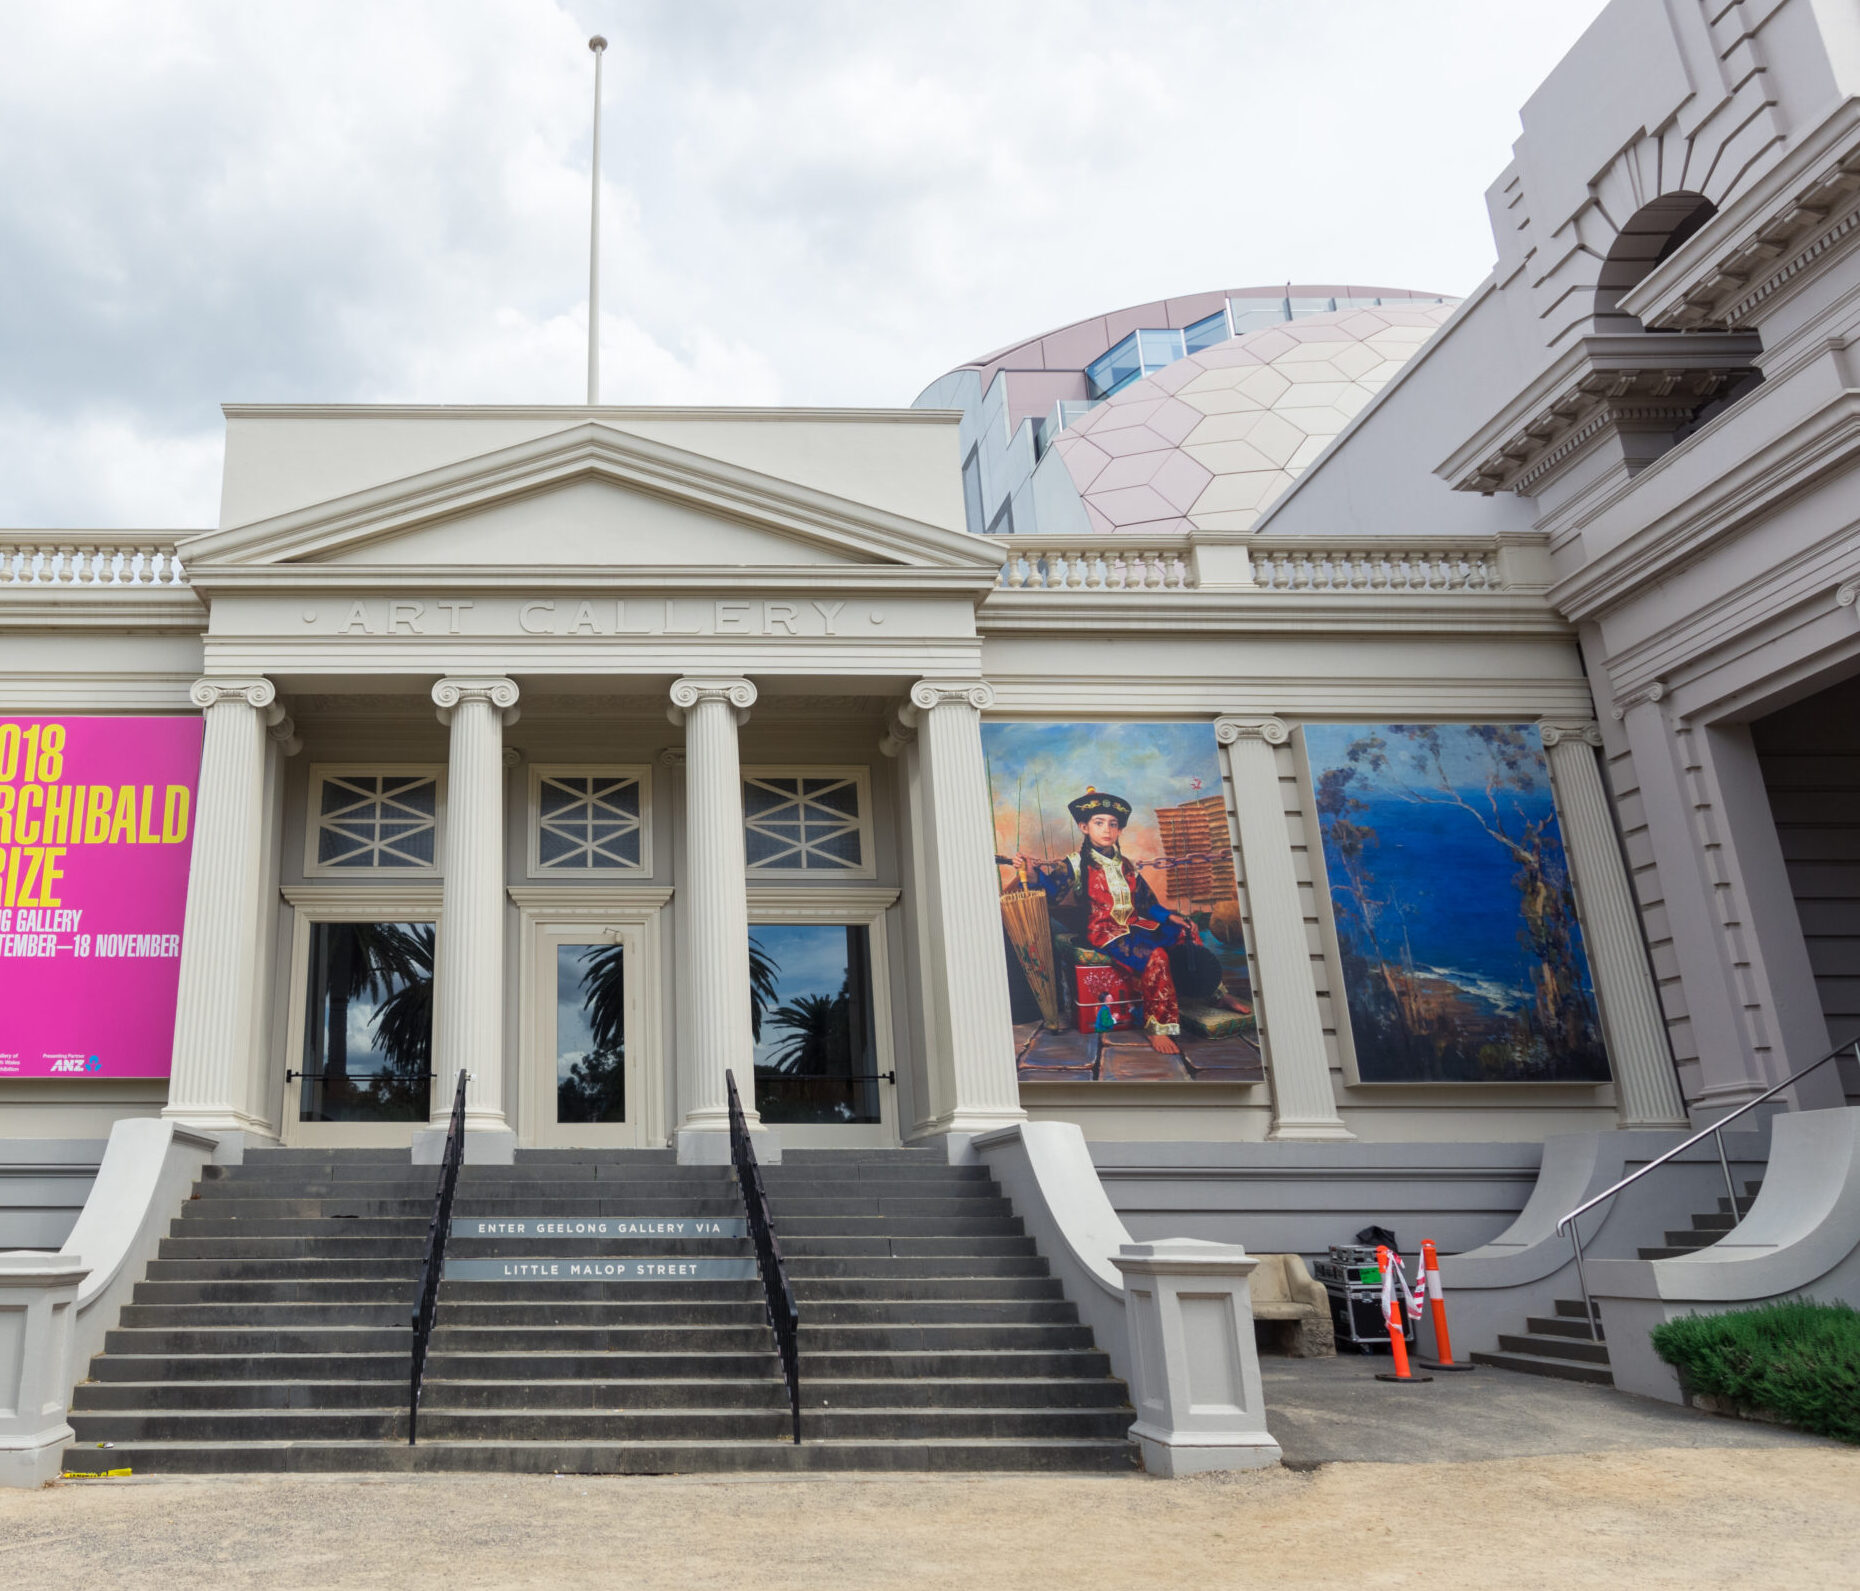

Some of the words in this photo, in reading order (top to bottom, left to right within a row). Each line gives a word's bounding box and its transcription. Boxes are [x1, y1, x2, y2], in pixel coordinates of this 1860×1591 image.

[338, 600, 474, 634] ART
[519, 600, 848, 635] GALLERY
[16, 909, 83, 932] GALLERY
[95, 934, 180, 957] NOVEMBER
[50, 1059, 85, 1072] ANZ
[478, 1223, 525, 1233] ENTER
[536, 1223, 607, 1233] GEELONG
[618, 1223, 685, 1233] GALLERY
[696, 1223, 721, 1233] VIA
[504, 1264, 559, 1275] LITTLE
[570, 1264, 626, 1275] MALOP
[636, 1264, 697, 1275] STREET
